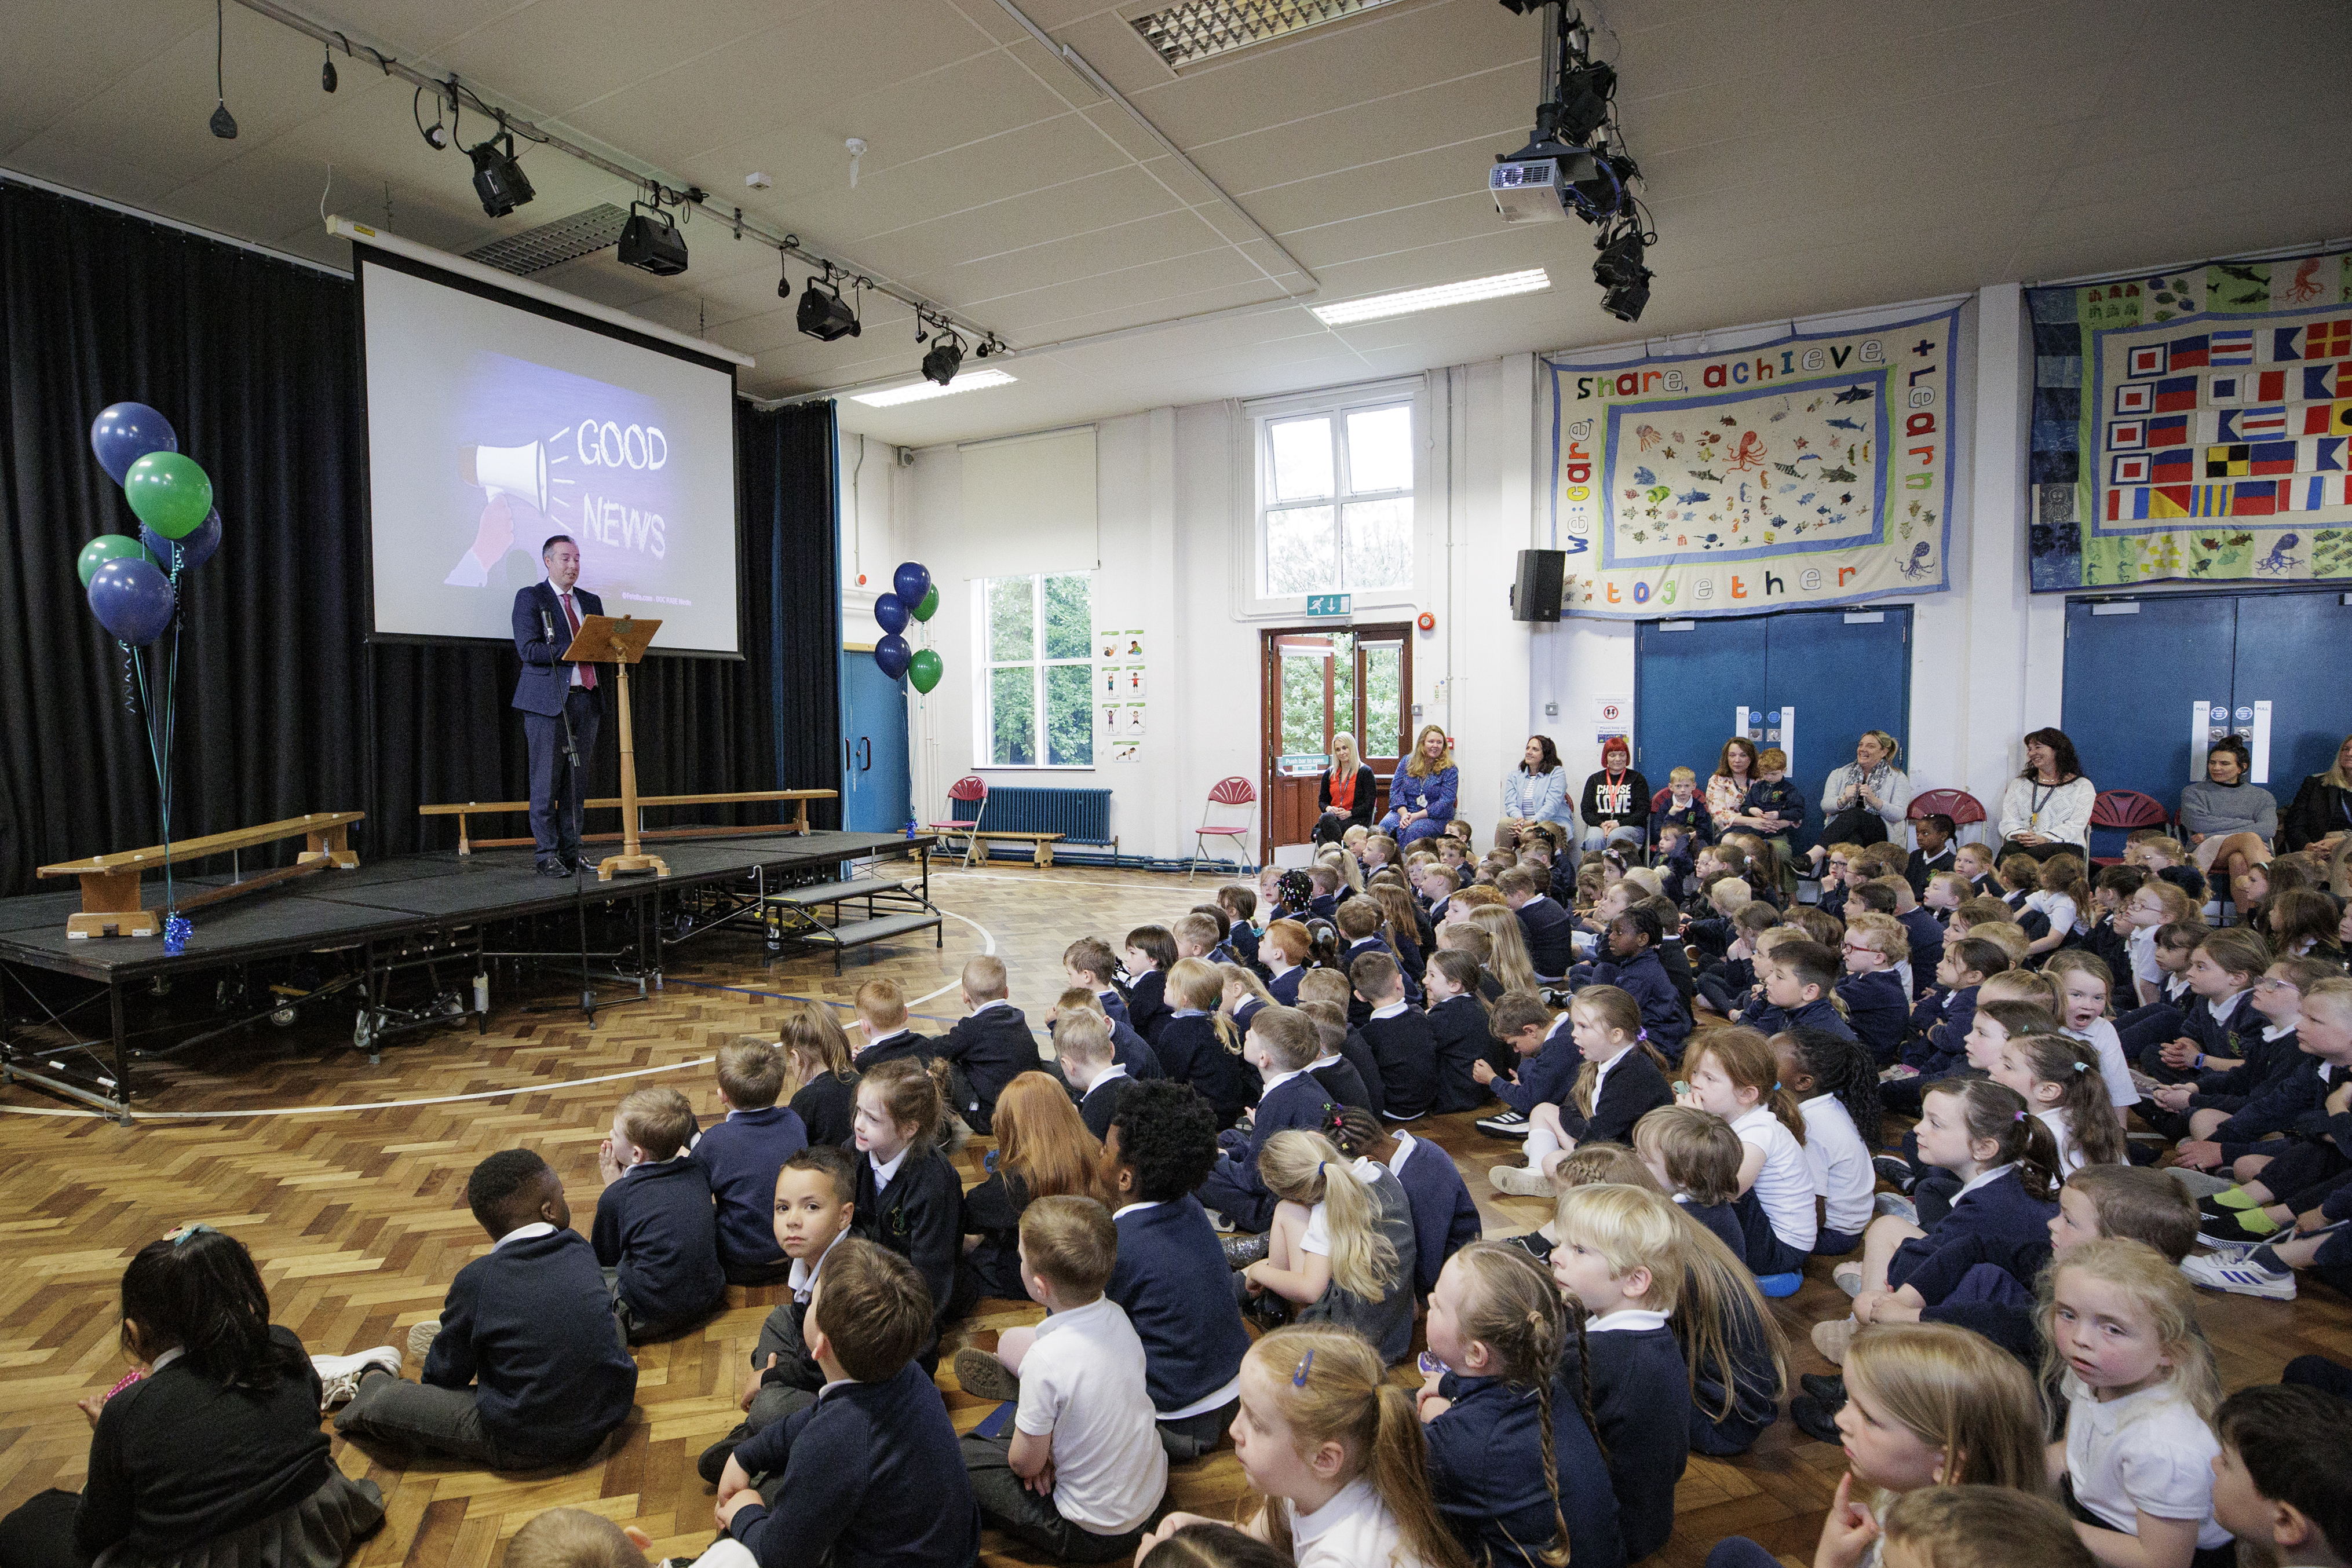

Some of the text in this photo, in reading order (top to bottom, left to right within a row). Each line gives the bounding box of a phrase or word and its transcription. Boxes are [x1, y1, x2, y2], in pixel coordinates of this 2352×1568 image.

[577, 419, 667, 470] GOOD
[583, 492, 666, 560] NEWS
[1607, 566, 1856, 605] together
[1596, 794, 1631, 813] LOVE
